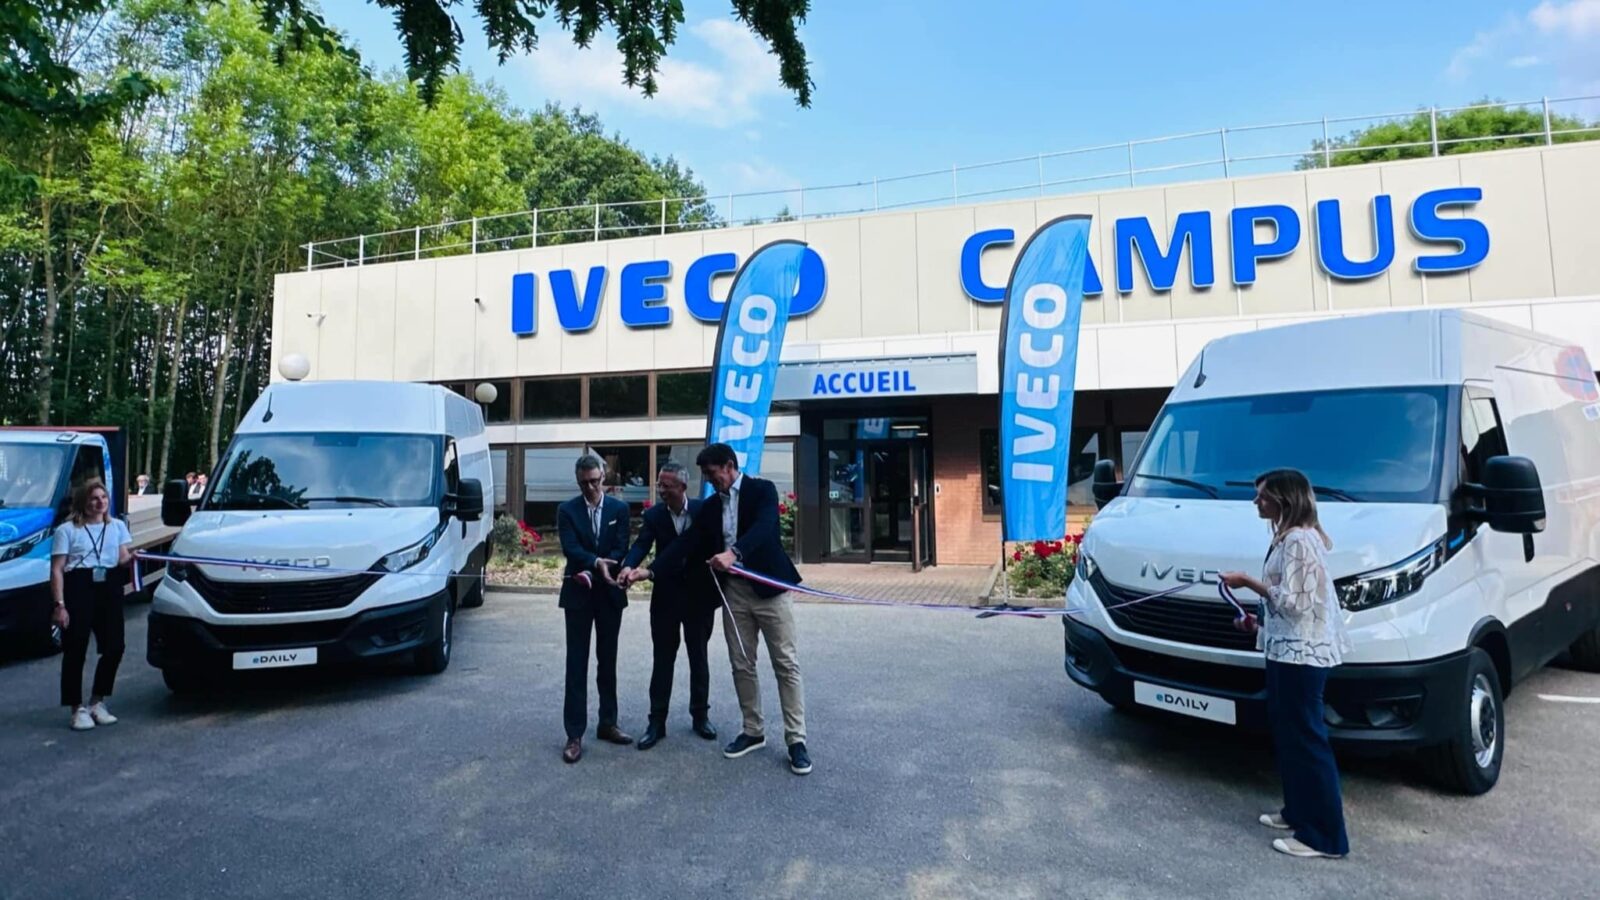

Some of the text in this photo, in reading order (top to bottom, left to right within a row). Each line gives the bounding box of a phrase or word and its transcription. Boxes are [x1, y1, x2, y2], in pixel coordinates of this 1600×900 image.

[960, 187, 1491, 302] CMPUS
[813, 370, 917, 395] ACCUEIL
[1013, 282, 1068, 482] IVECO
[1140, 560, 1221, 586] IVEC
[252, 653, 298, 664] eDAILY
[1156, 693, 1209, 711] eDAILY
